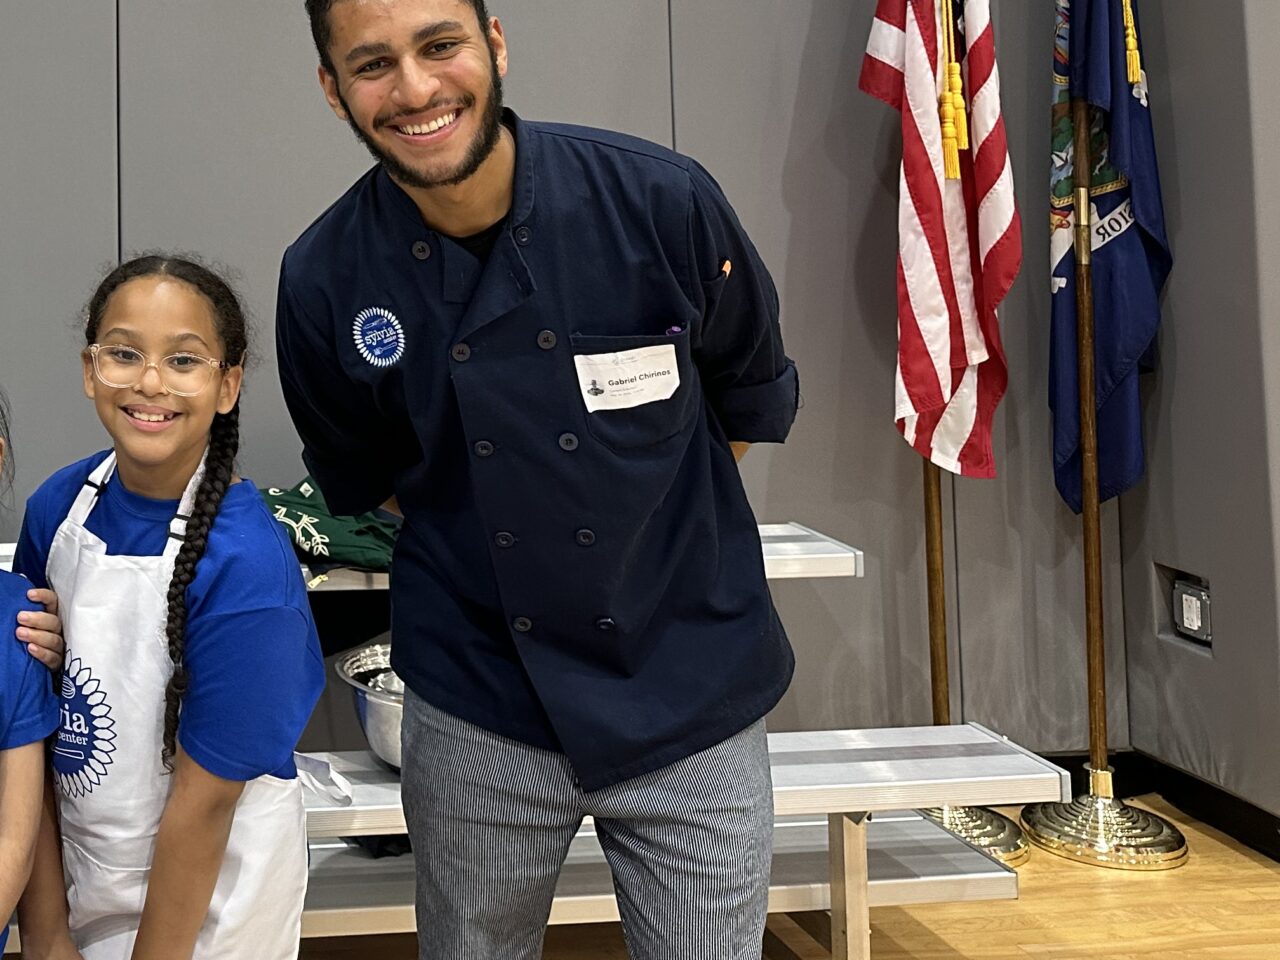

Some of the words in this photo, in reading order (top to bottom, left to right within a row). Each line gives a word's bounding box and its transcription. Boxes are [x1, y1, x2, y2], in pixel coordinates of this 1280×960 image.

[364, 326, 397, 346] sylvia
[607, 375, 637, 386] Gabriel
[638, 369, 671, 381] Chirinos
